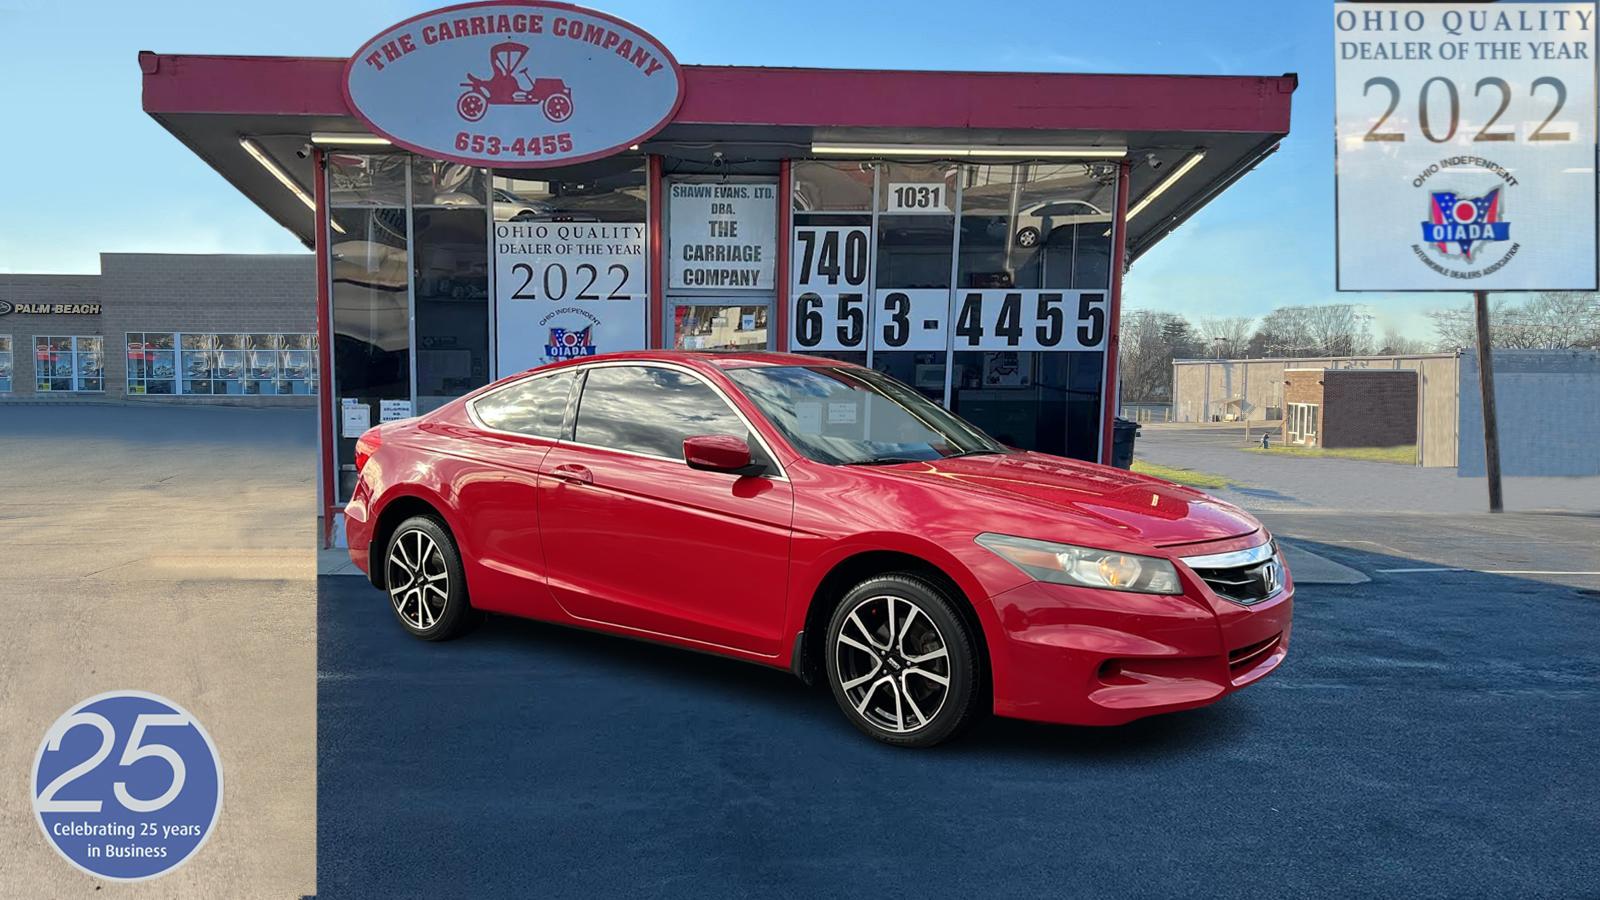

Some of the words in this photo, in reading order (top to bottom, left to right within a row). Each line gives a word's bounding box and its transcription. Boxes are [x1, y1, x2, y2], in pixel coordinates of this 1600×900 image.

[1336, 10, 1425, 31] OHIO
[1442, 10, 1593, 35] QUALITY
[367, 34, 415, 71] THE
[423, 15, 543, 45] CARRIAGE
[554, 18, 663, 76] COMPANY
[1341, 42, 1433, 60] DEALER
[1439, 42, 1469, 60] OF
[1475, 42, 1521, 60] THE
[1528, 41, 1589, 60] YEAR
[1363, 76, 1571, 143] 2022
[455, 132, 573, 156] 653-4455
[1413, 164, 1439, 188] OHIO
[1440, 156, 1519, 187] INDEPENDENT
[673, 186, 711, 198] SHAWN
[714, 187, 750, 199] EVANS.
[754, 187, 774, 199] LTD.
[894, 187, 940, 208] 1031
[711, 203, 736, 214] DBA.
[497, 226, 548, 238] OHIO
[557, 226, 644, 240] QUALITY
[708, 221, 737, 237] THE
[1432, 223, 1496, 241] OIADA
[500, 244, 552, 254] DEALER
[555, 244, 574, 254] OF
[576, 244, 604, 254] THE
[606, 244, 641, 255] YEAR
[683, 244, 762, 262] CARRIAGE
[797, 230, 867, 286] 740
[511, 263, 631, 300] 2022
[683, 268, 760, 286] COMPANY
[15, 304, 50, 314] PALM
[55, 304, 100, 314] BEACH
[539, 312, 555, 326] OHIO
[555, 307, 601, 326] INDEPENDENT
[795, 292, 1105, 348] 653-4455
[551, 346, 587, 356] OIADA
